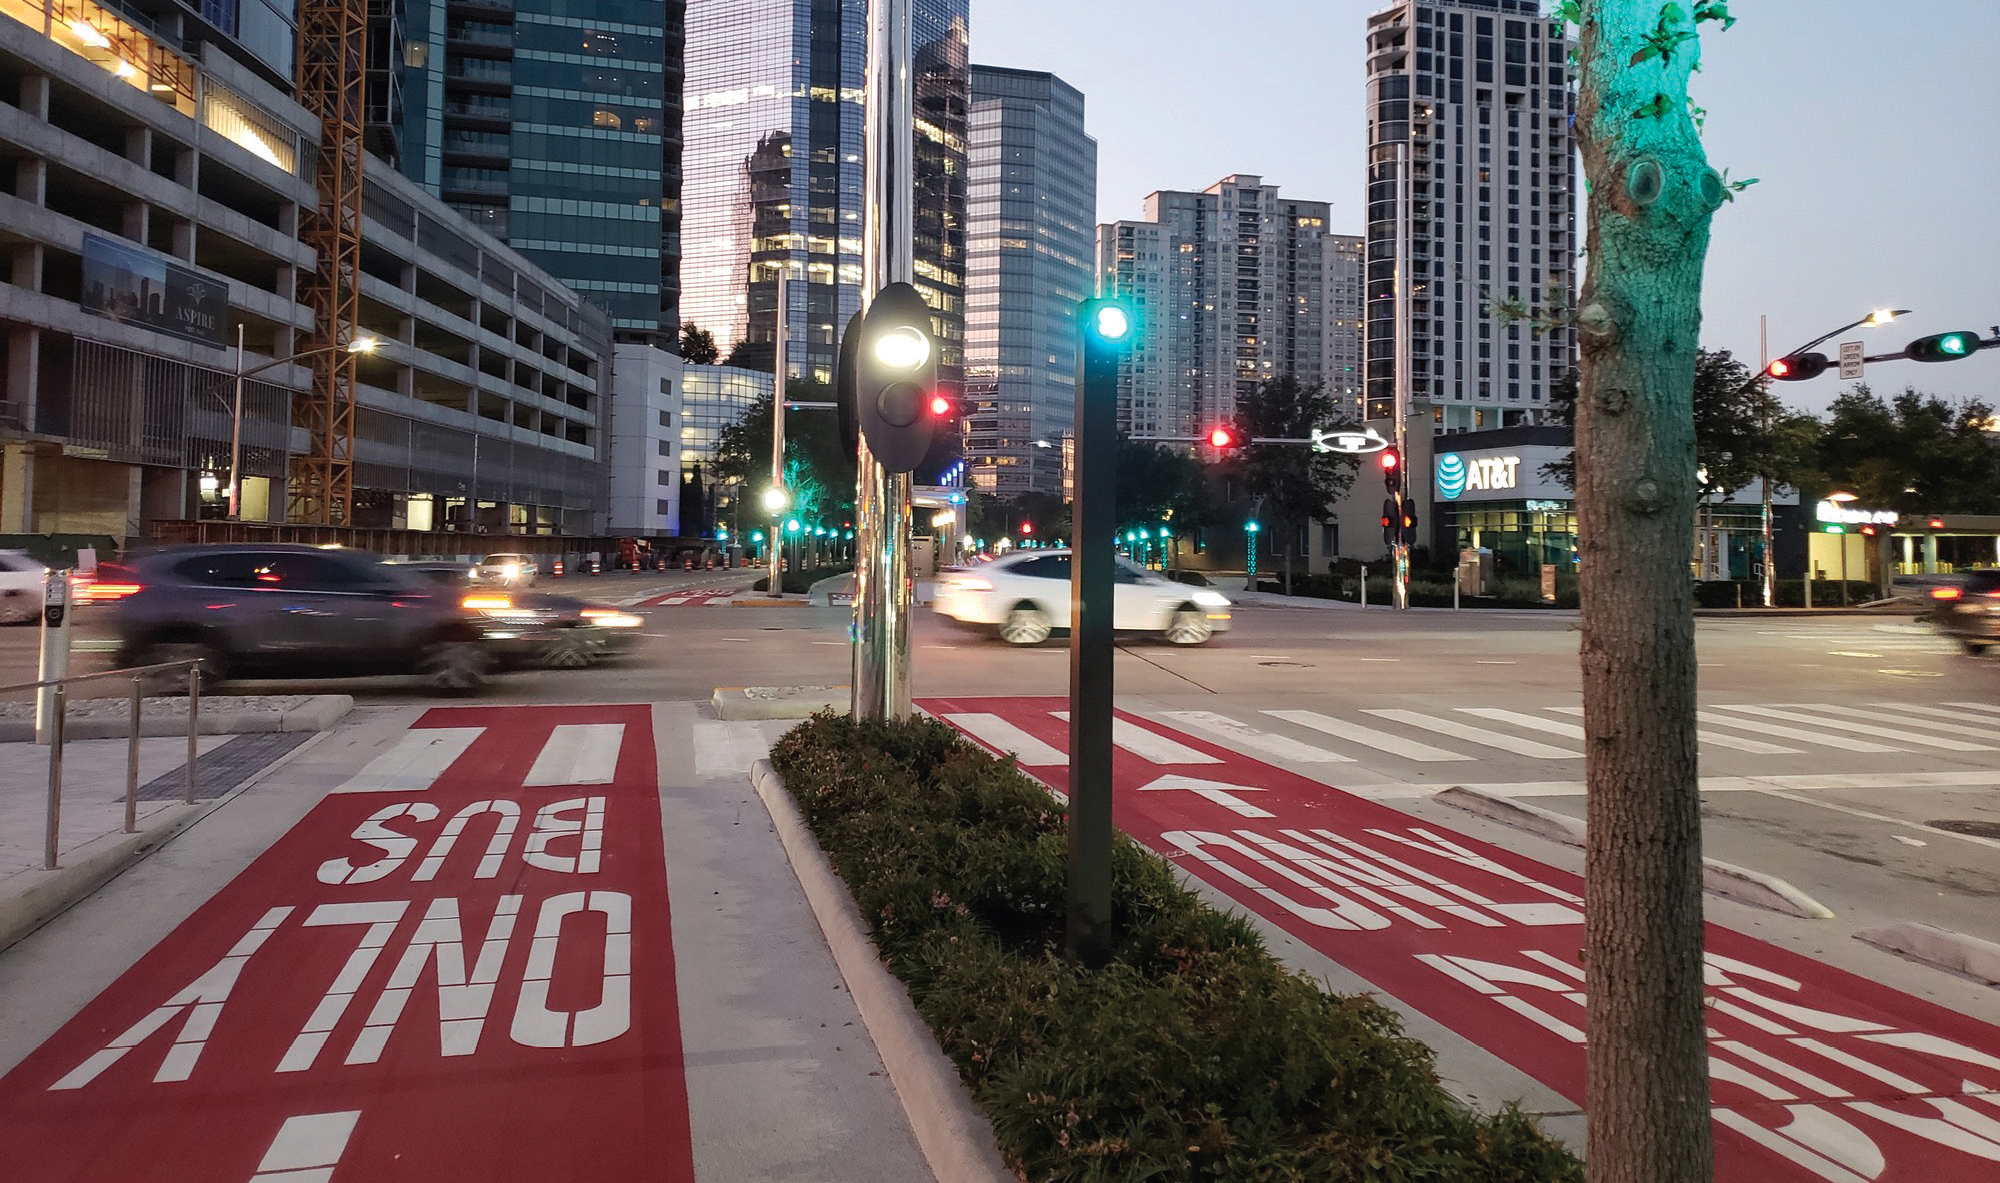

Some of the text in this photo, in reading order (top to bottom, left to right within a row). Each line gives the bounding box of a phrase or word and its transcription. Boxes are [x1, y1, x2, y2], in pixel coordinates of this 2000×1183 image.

[175, 306, 215, 330] ASPIRE
[1466, 456, 1520, 490] AT&T
[316, 796, 606, 885] BUS
[1160, 827, 1586, 931] ONLY
[47, 890, 632, 1091] ONLY
